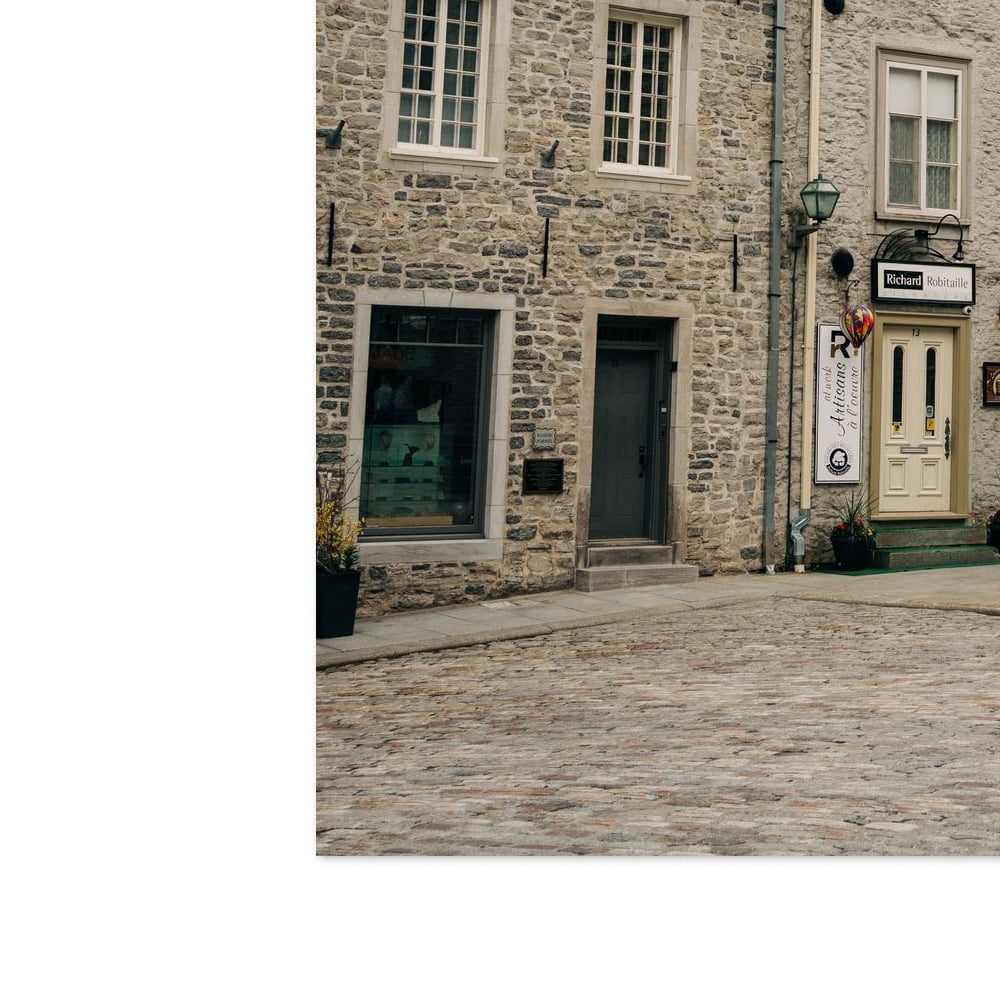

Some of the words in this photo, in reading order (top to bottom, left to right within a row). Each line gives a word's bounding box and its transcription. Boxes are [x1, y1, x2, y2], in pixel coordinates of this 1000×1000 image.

[886, 273, 921, 286] Richard
[927, 276, 969, 289] Robitaille
[912, 328, 920, 336] 13
[821, 366, 832, 390] work
[830, 362, 847, 437] Artisans
